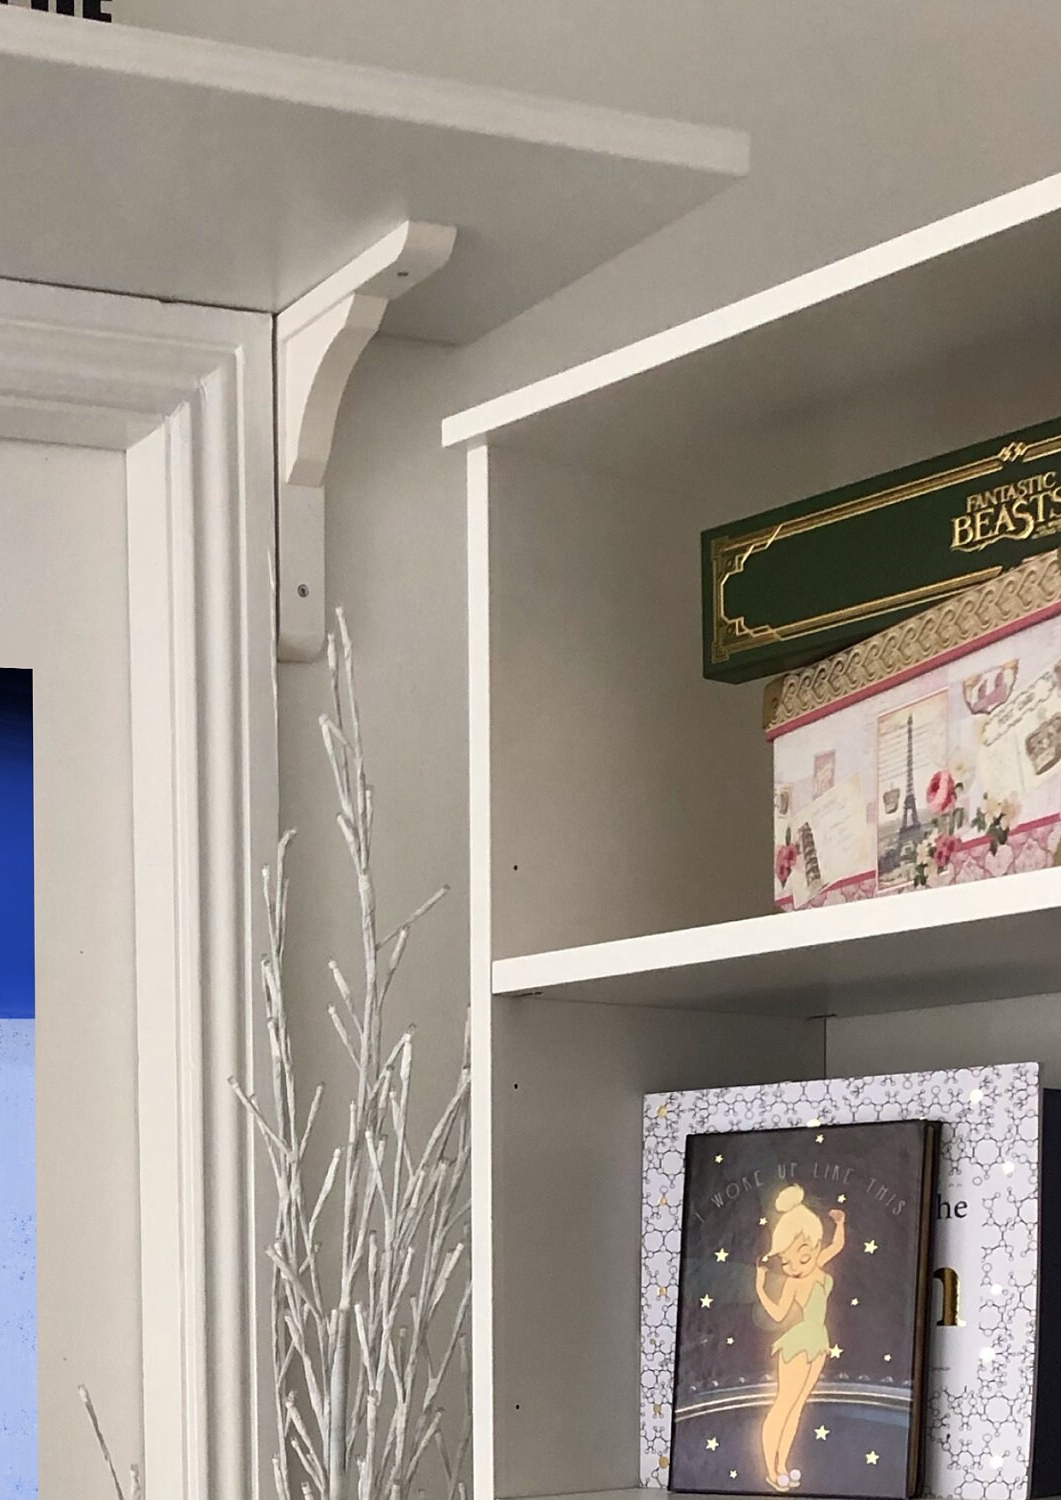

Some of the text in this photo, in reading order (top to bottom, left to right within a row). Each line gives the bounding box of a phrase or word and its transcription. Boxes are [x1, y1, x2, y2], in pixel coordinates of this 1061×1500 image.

[966, 471, 1056, 513] FANTASTIC
[710, 1168, 765, 1209] WOKE
[777, 1161, 798, 1180] UP
[813, 1161, 855, 1186] LIKE
[865, 1176, 907, 1217] THIS
[936, 1194, 968, 1220] he
